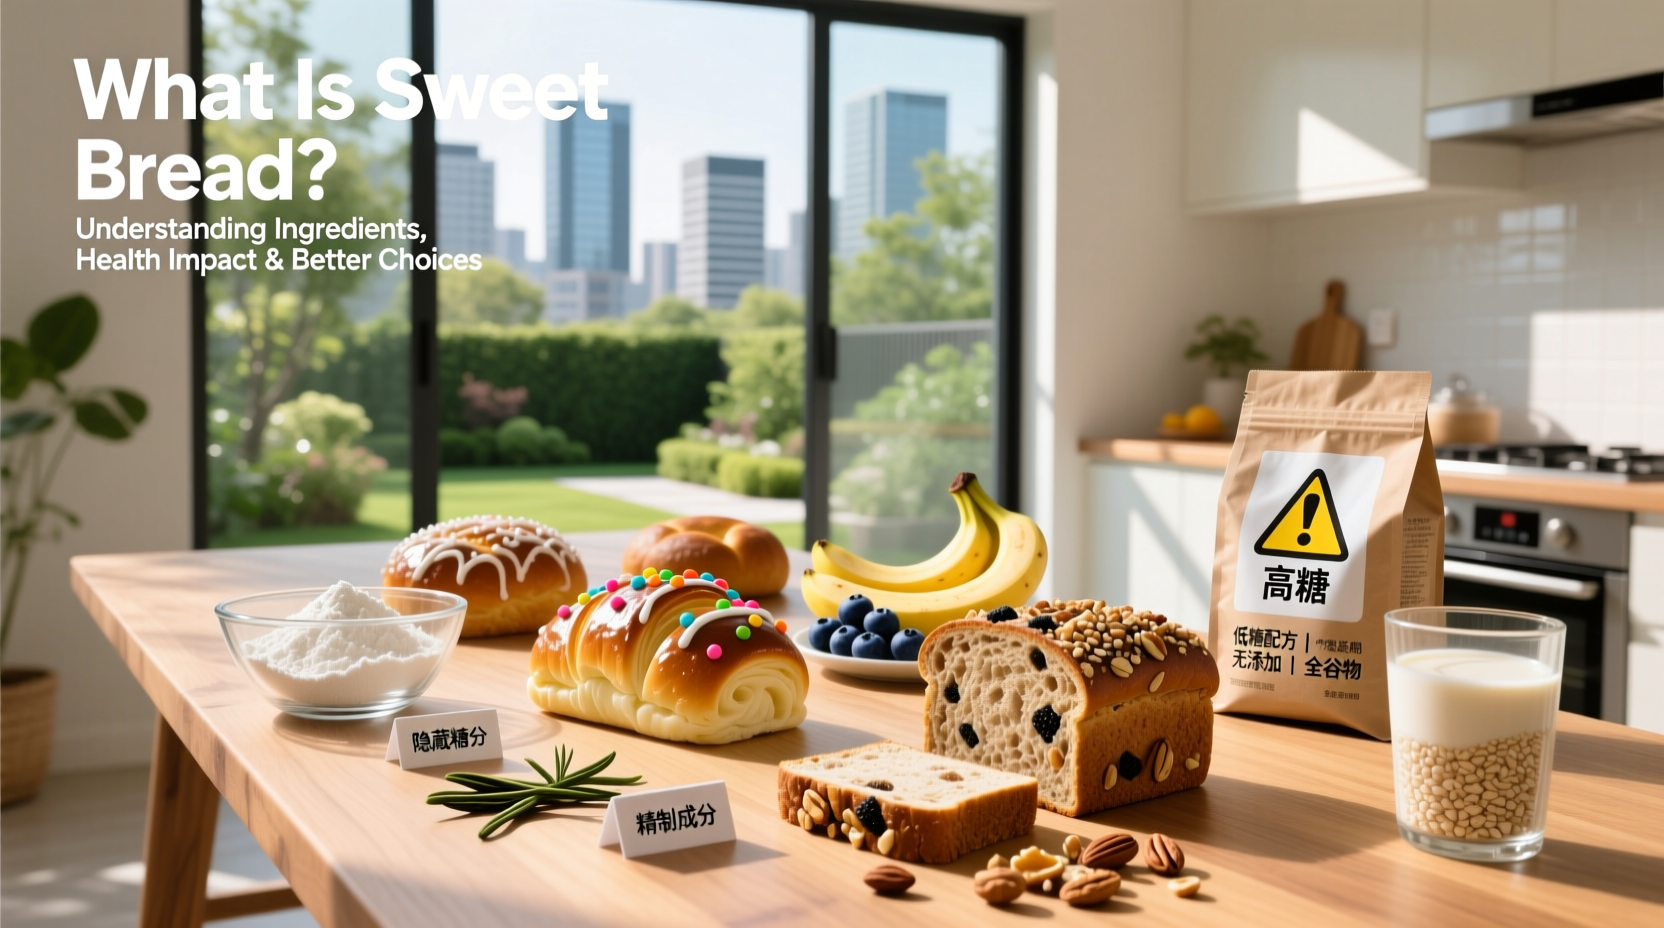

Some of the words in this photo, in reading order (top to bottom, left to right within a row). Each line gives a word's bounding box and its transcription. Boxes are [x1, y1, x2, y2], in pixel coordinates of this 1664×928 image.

[1262, 564, 1330, 605] 高糖
[1232, 649, 1282, 673] 无添加
[1304, 656, 1362, 681] 全谷物
[636, 803, 717, 836] 精制成分
